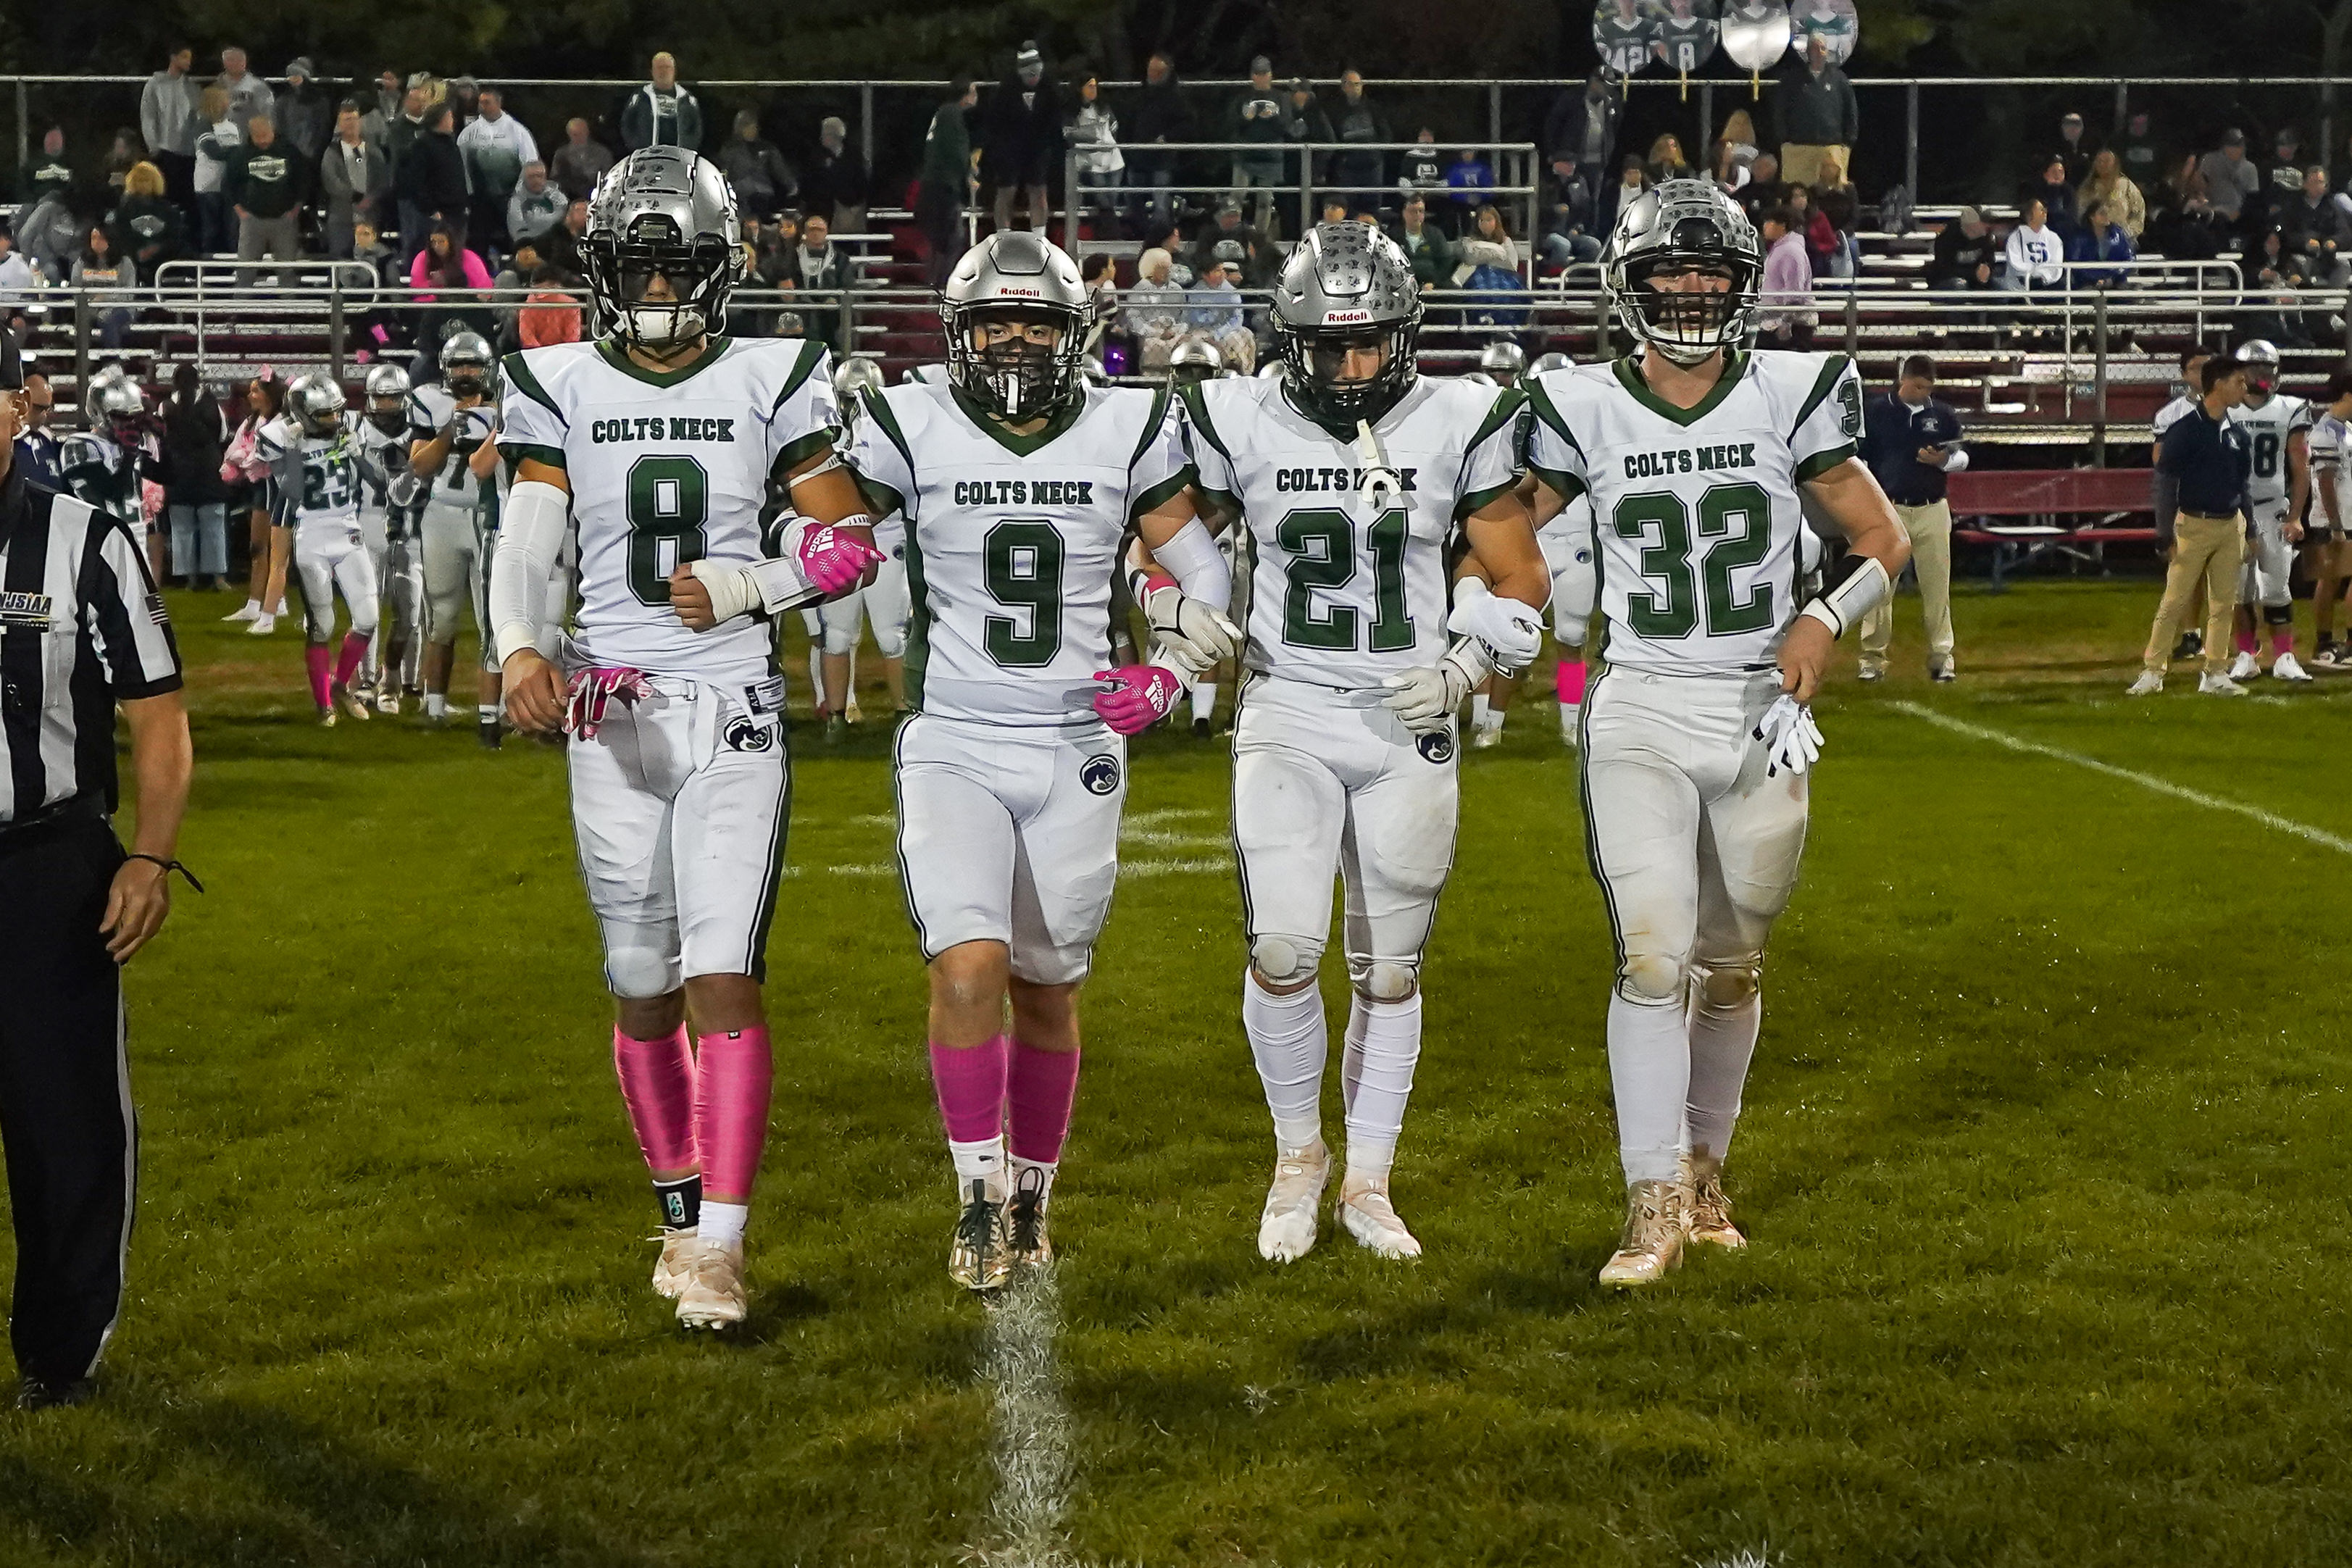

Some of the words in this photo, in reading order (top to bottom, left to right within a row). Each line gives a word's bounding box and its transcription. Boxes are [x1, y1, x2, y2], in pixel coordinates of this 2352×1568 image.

[1001, 288, 1040, 297] Riddell
[1328, 312, 1367, 322] Riddell
[592, 417, 664, 443] COLTS
[670, 417, 735, 442] NECK
[1276, 468, 1348, 491] COLTS
[1353, 467, 1417, 491] NK
[1624, 449, 1693, 479] COLTS
[1696, 443, 1756, 471] NECK
[954, 481, 1027, 505] COLTS
[1031, 481, 1093, 504] NECK
[626, 454, 709, 607] 8
[1612, 481, 1775, 640] 32
[983, 519, 1065, 668] 9
[1276, 507, 1417, 653] 21
[1152, 674, 1164, 713] adidas
